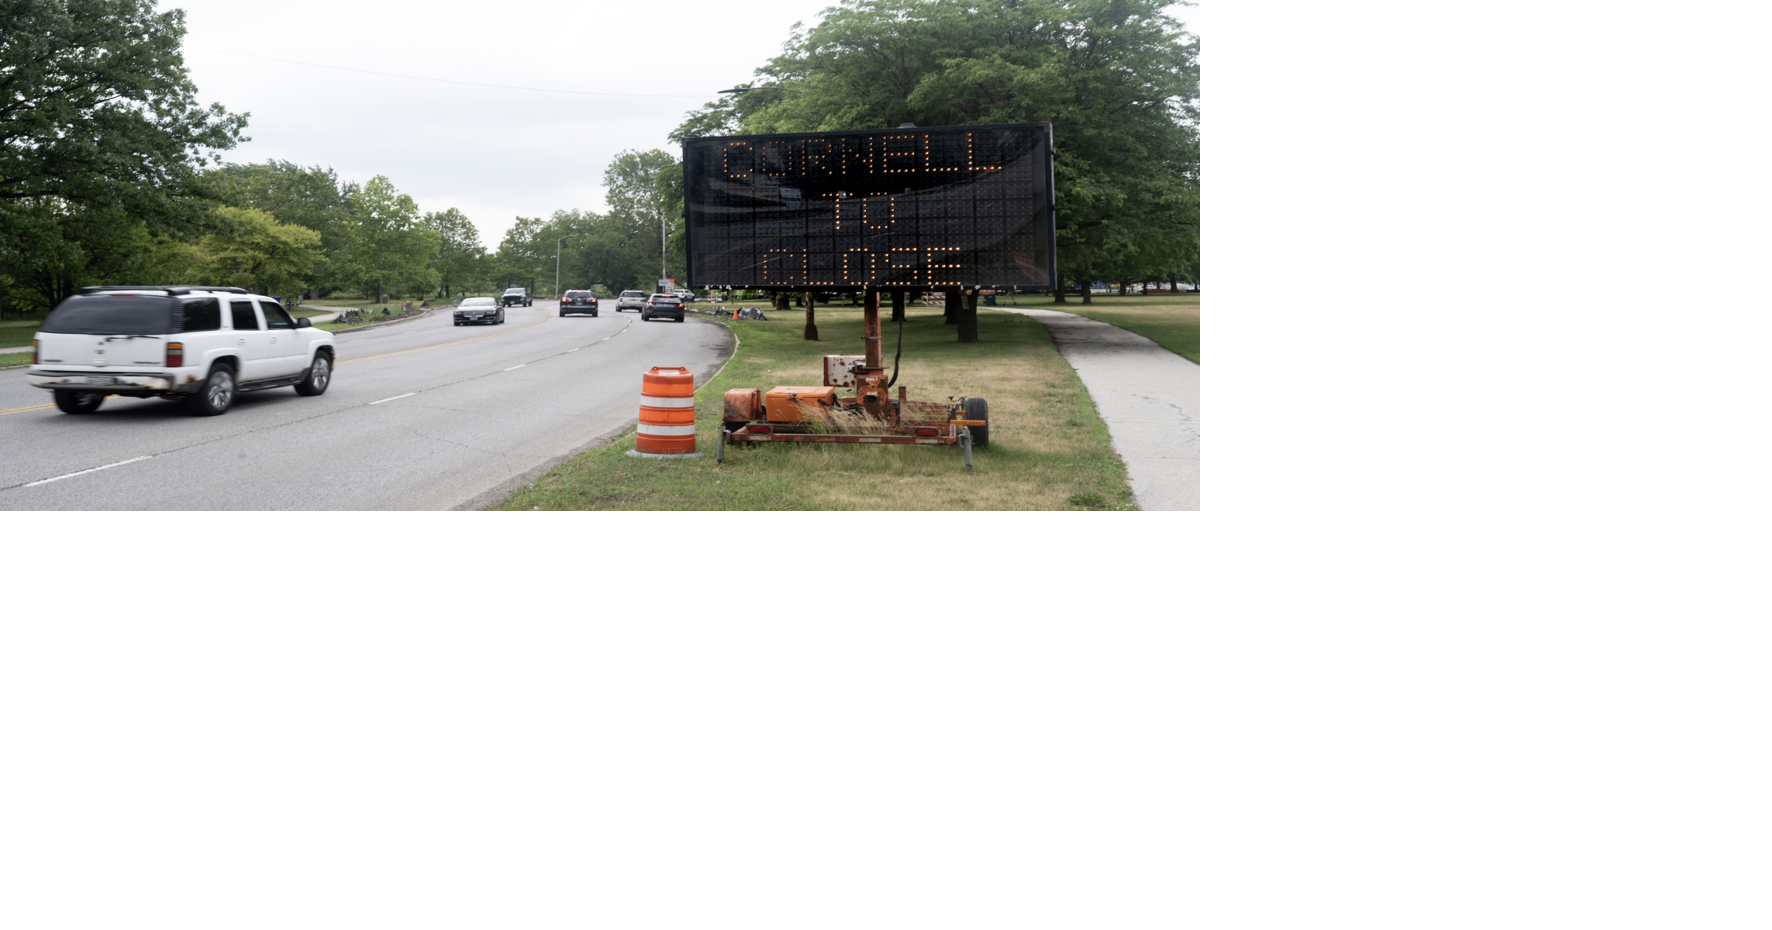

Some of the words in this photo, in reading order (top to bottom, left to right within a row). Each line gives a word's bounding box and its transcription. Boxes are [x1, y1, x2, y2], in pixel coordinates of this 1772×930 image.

[723, 132, 1002, 178] CORNELL
[822, 191, 895, 230] TO
[763, 246, 962, 285] CLOSE
